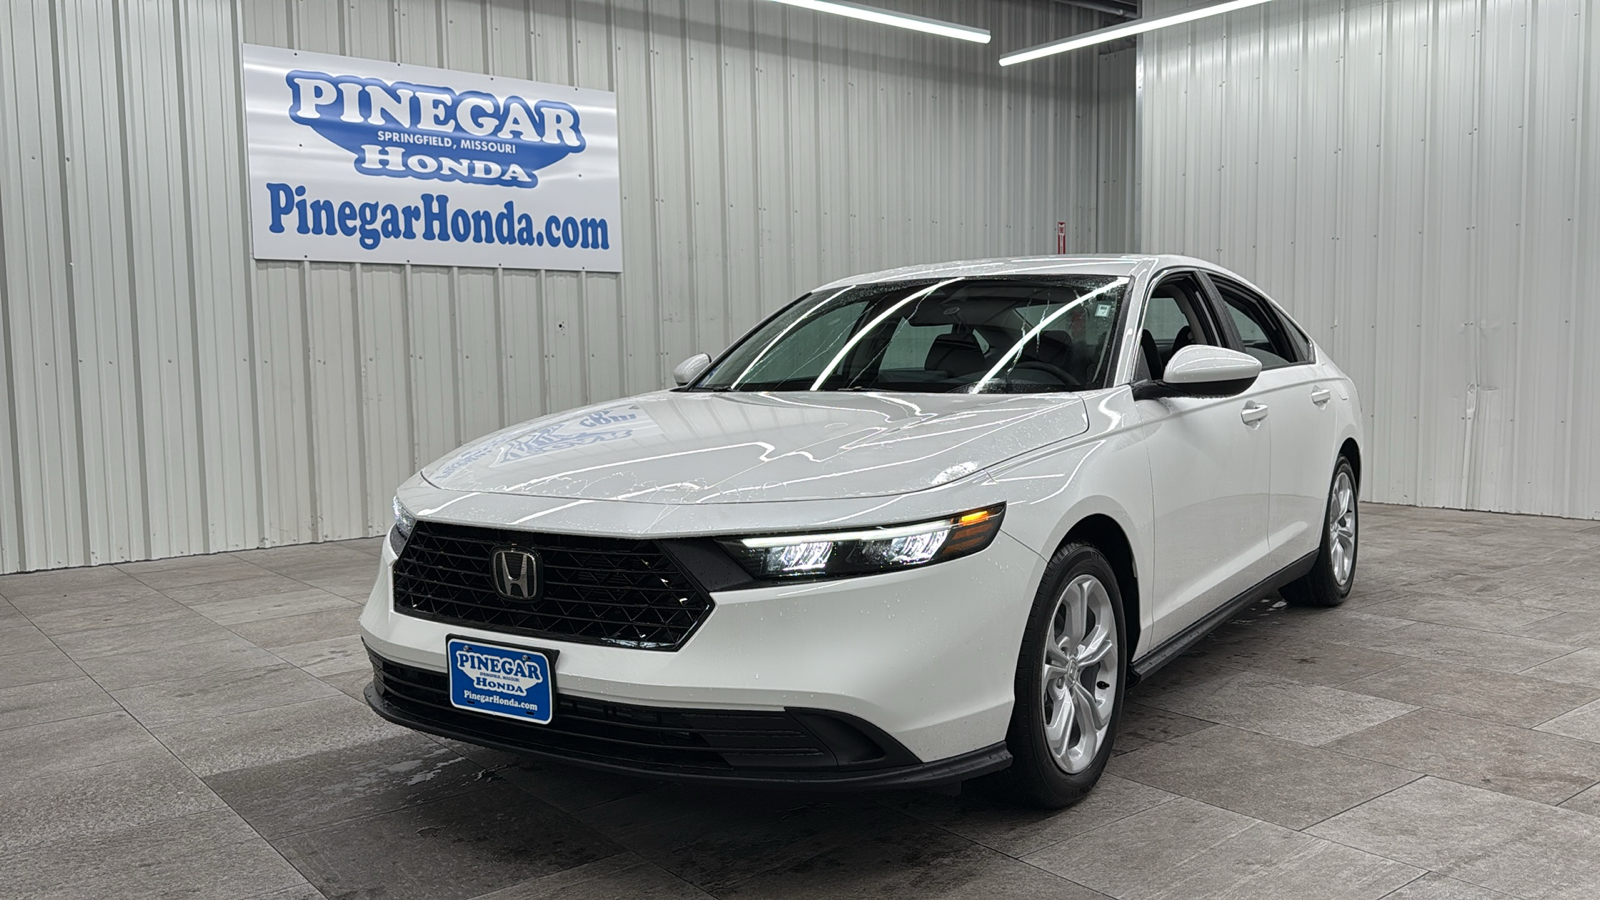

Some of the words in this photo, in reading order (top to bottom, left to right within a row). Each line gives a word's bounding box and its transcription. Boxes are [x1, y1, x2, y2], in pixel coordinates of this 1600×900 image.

[294, 77, 581, 147] PINEGAR
[377, 130, 458, 150] SPRINGFIELD,
[460, 139, 516, 154] MISSOURI
[361, 145, 532, 182] HONDA
[266, 183, 610, 250] PinegarHonda.com
[458, 653, 540, 680] PINEGAR
[475, 677, 525, 694] HONDA
[463, 690, 538, 711] PinegarHonda.com
